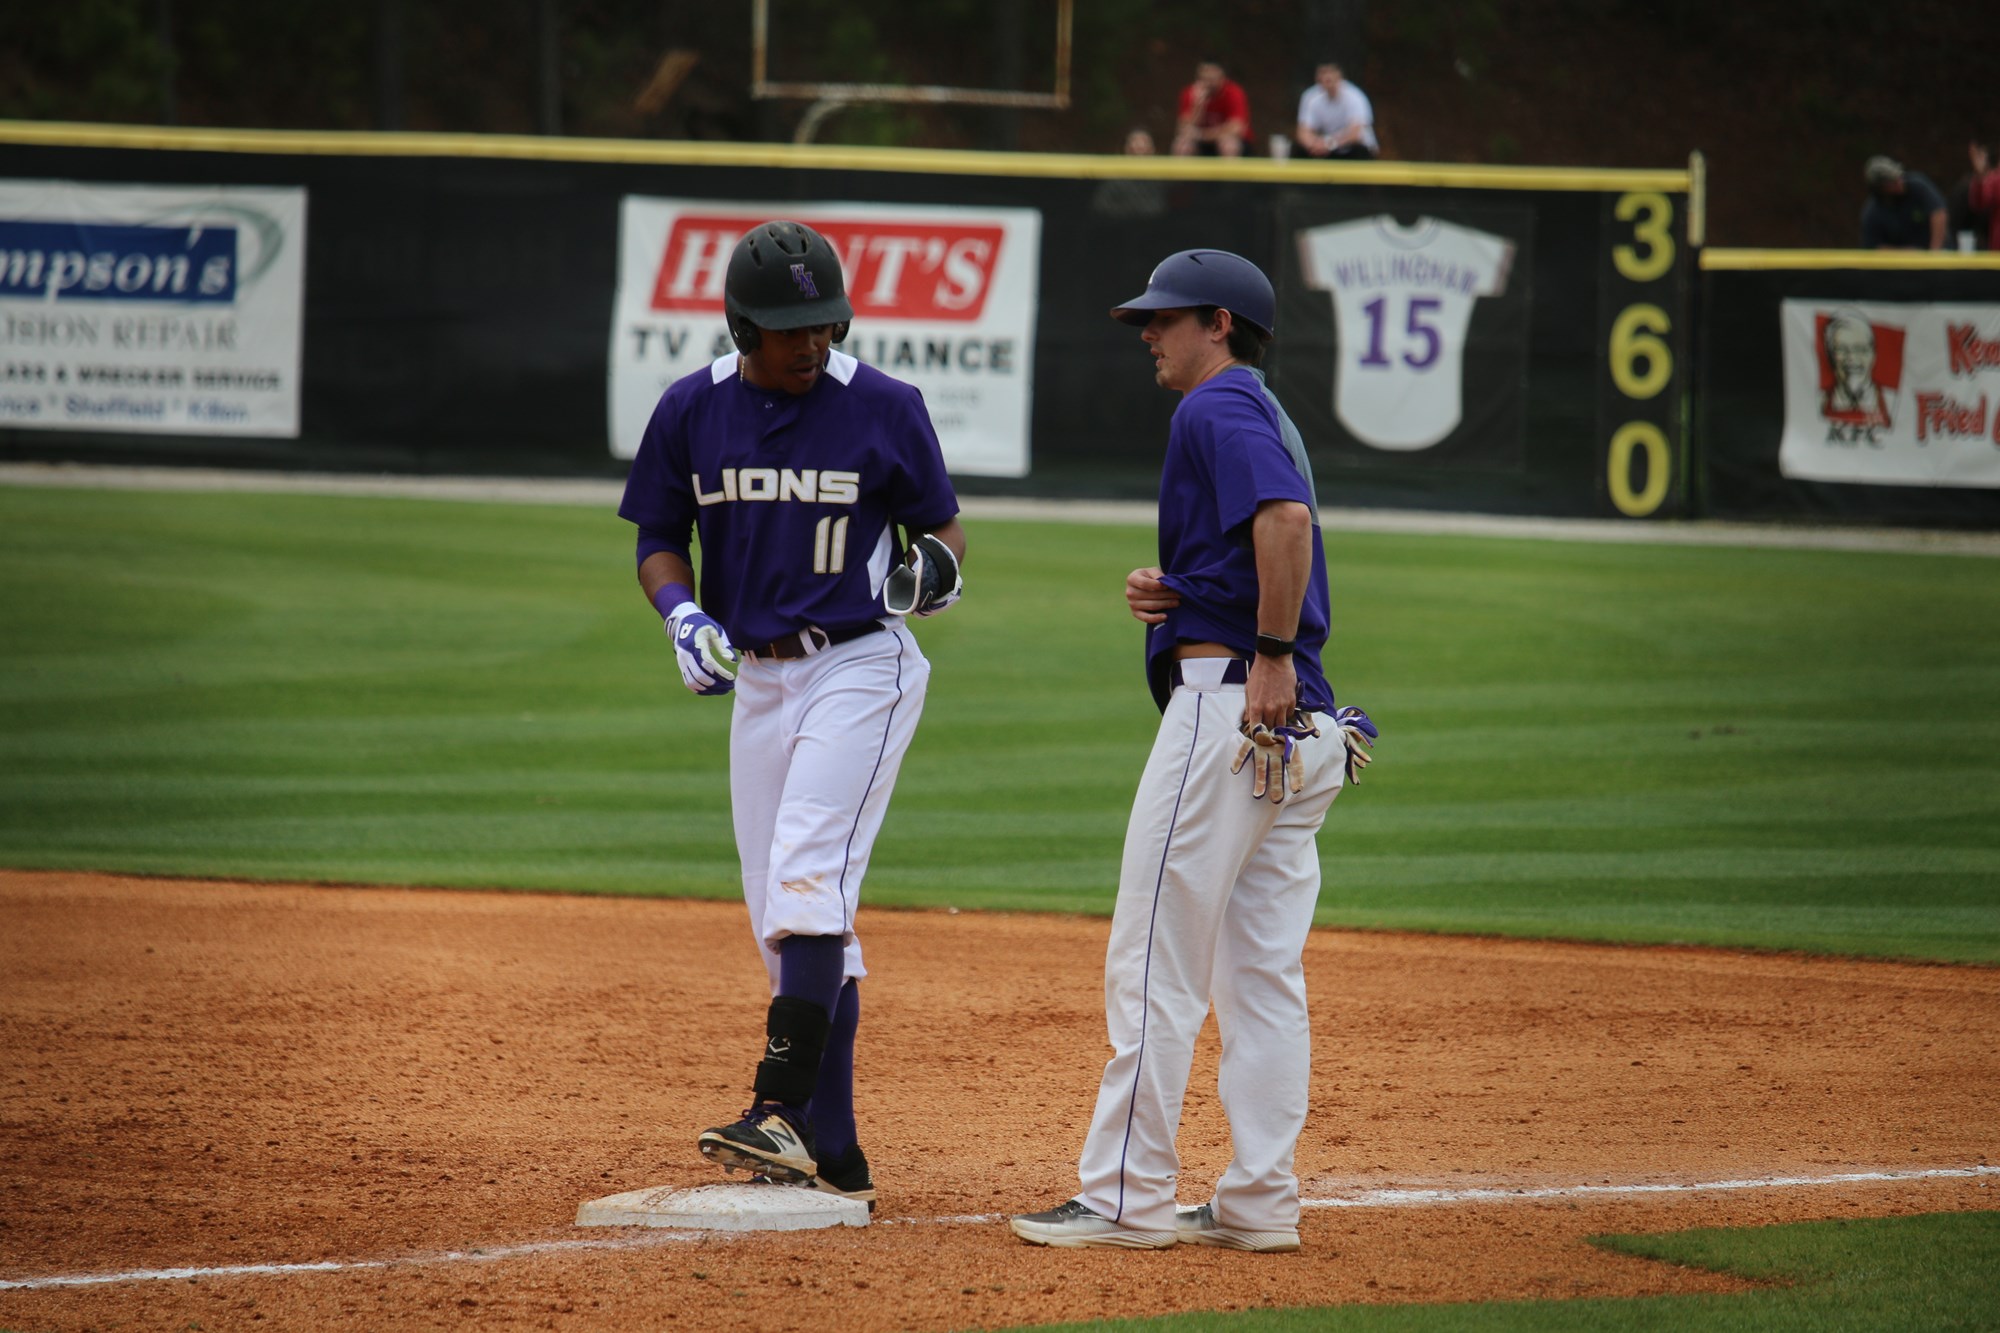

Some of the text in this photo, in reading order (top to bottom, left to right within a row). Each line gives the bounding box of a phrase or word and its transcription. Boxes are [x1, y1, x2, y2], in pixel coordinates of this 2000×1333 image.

[667, 229, 992, 311] HNT'S
[113, 317, 239, 352] REPAIR
[633, 326, 689, 360] TV
[1357, 297, 1442, 371] 15
[1607, 191, 1676, 518] 360
[1827, 422, 1882, 446] KFC
[1916, 391, 1987, 441] Fried
[692, 468, 860, 506] LIONS
[813, 515, 849, 574] 11
